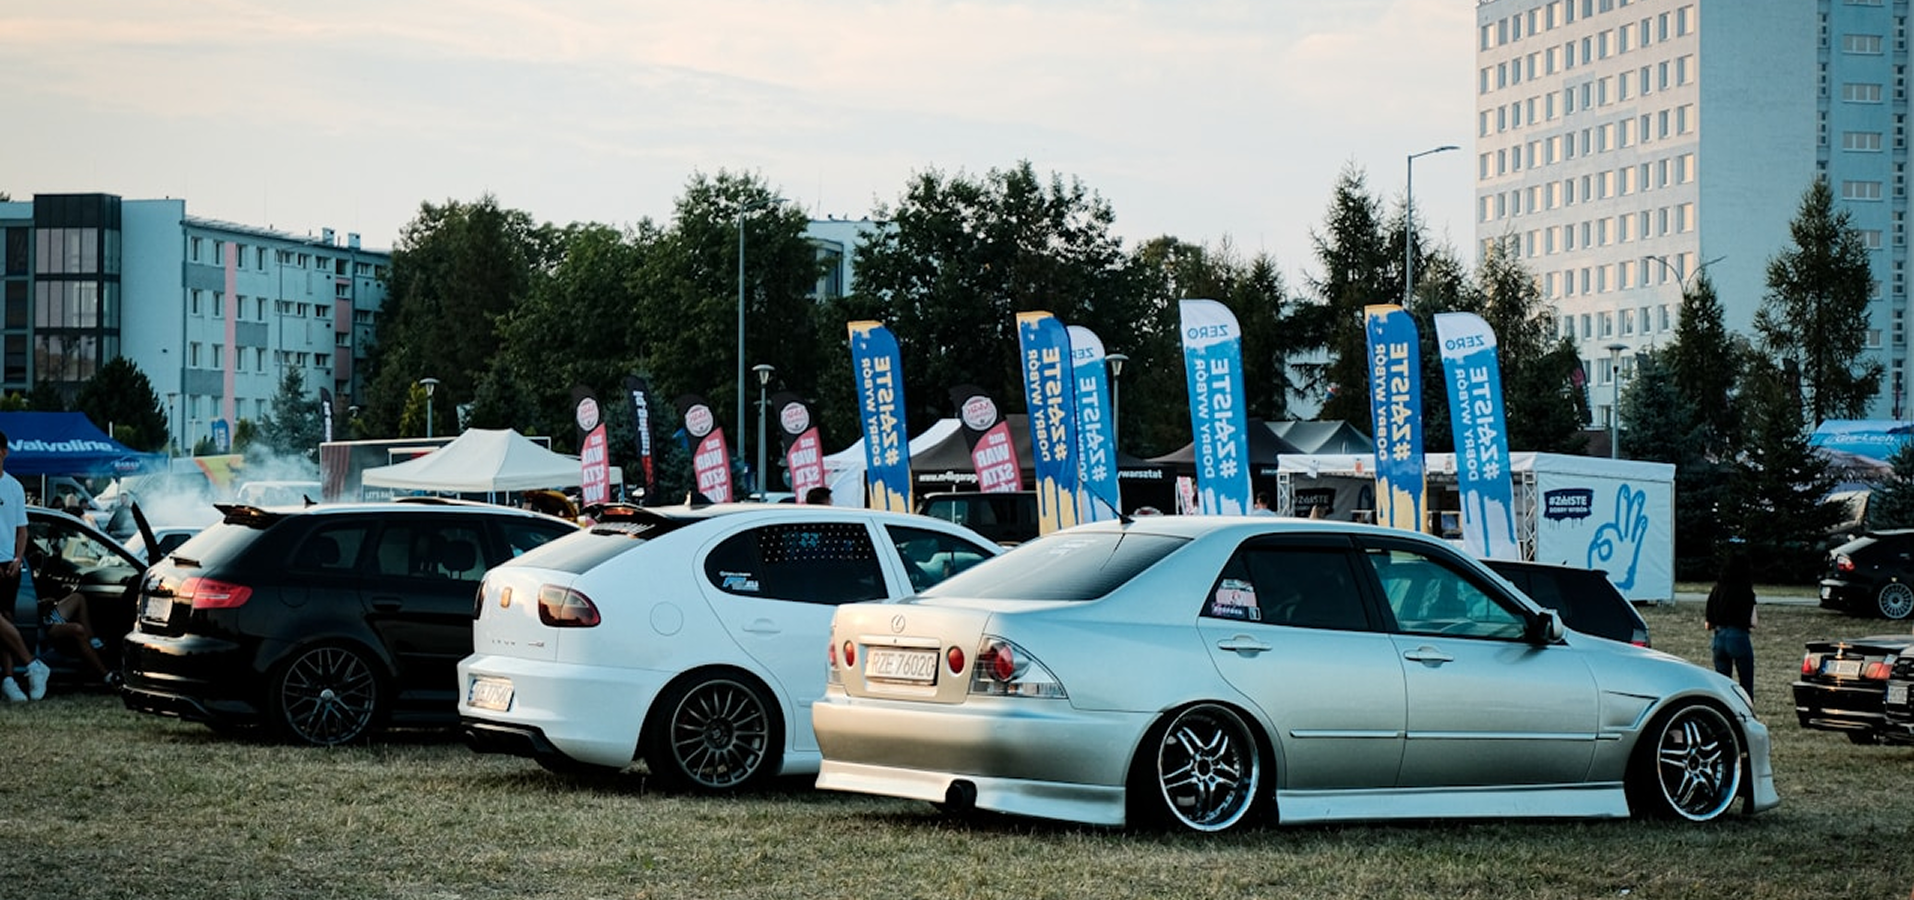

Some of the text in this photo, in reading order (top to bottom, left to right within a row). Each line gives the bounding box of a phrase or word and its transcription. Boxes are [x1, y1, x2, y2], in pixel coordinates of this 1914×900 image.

[8, 439, 113, 452] Valvoline
[872, 652, 934, 678] RZE 76020
